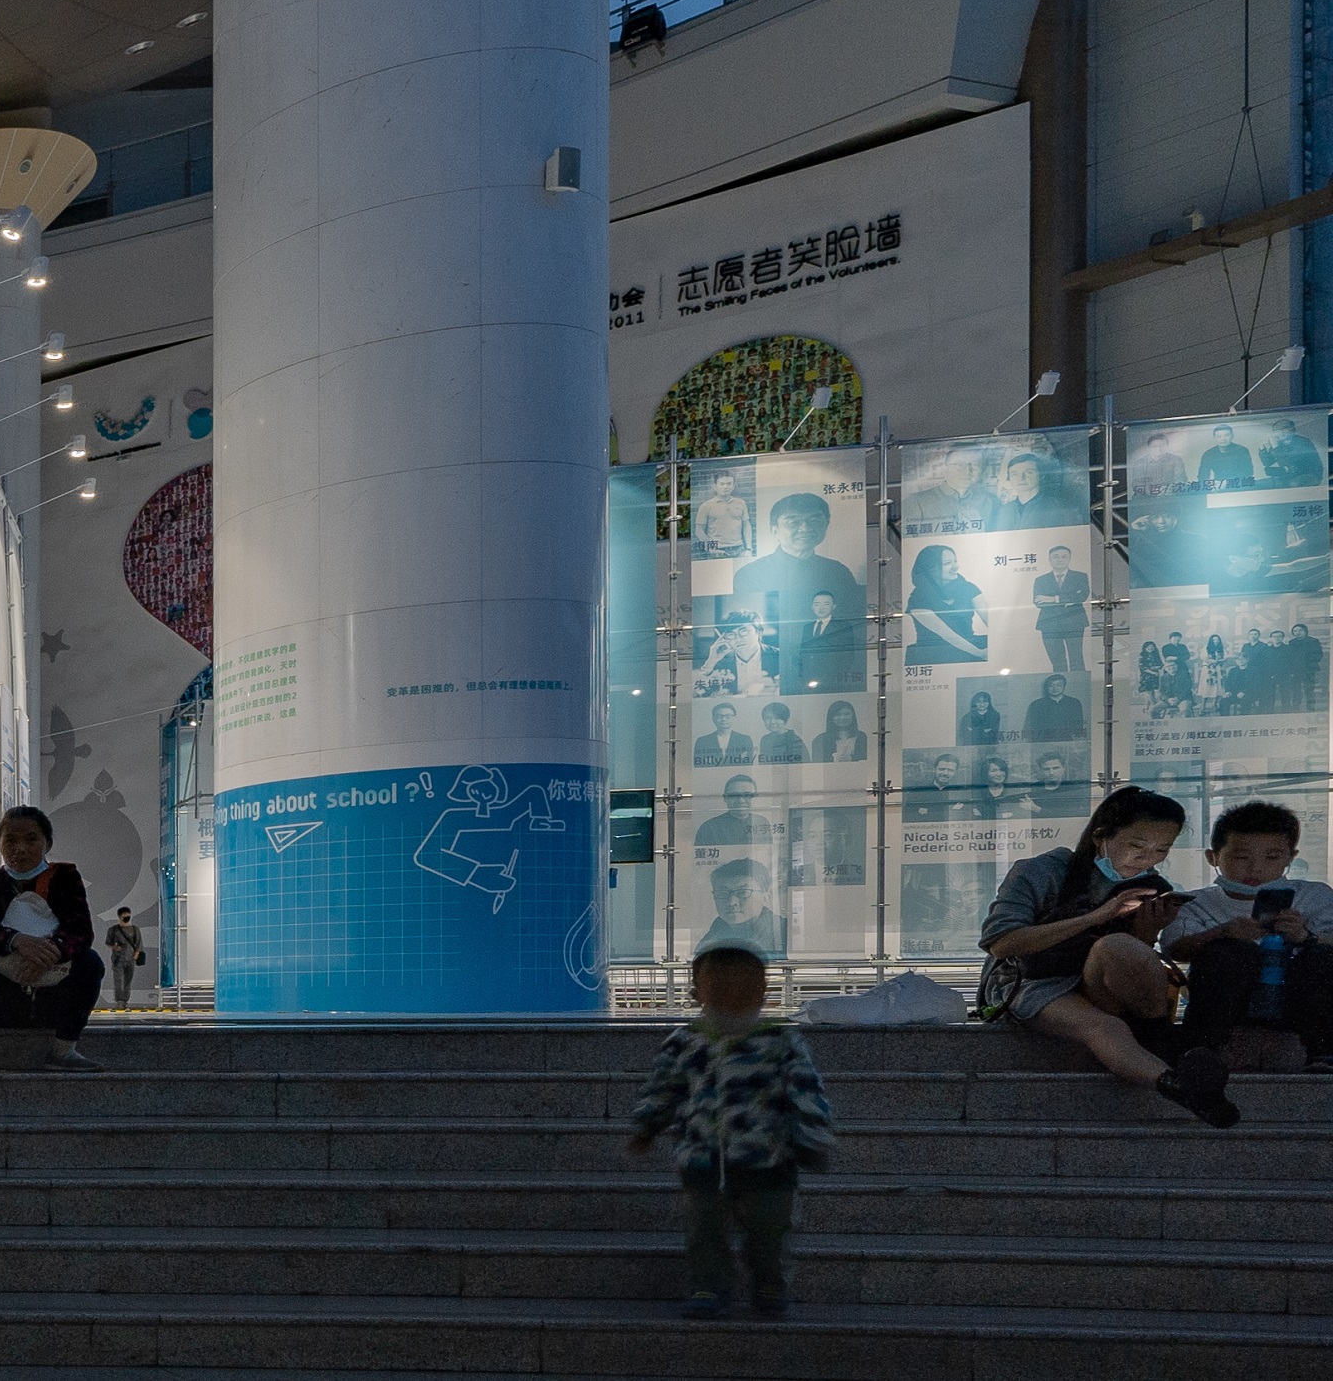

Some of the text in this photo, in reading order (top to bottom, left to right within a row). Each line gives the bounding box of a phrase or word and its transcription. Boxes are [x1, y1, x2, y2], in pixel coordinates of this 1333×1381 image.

[677, 214, 902, 302] 志愿者笑脸墙
[679, 305, 701, 317] The
[704, 293, 747, 311] Smiling
[751, 285, 788, 300] Faces
[791, 278, 804, 290] of
[806, 272, 826, 287] the
[823, 481, 863, 495] 张永和
[230, 799, 261, 822] thing
[266, 791, 317, 816] about
[326, 782, 397, 809] school
[904, 833, 949, 843] Nicola
[695, 847, 720, 859] 董功
[904, 841, 1026, 853] Federico Ruberto
